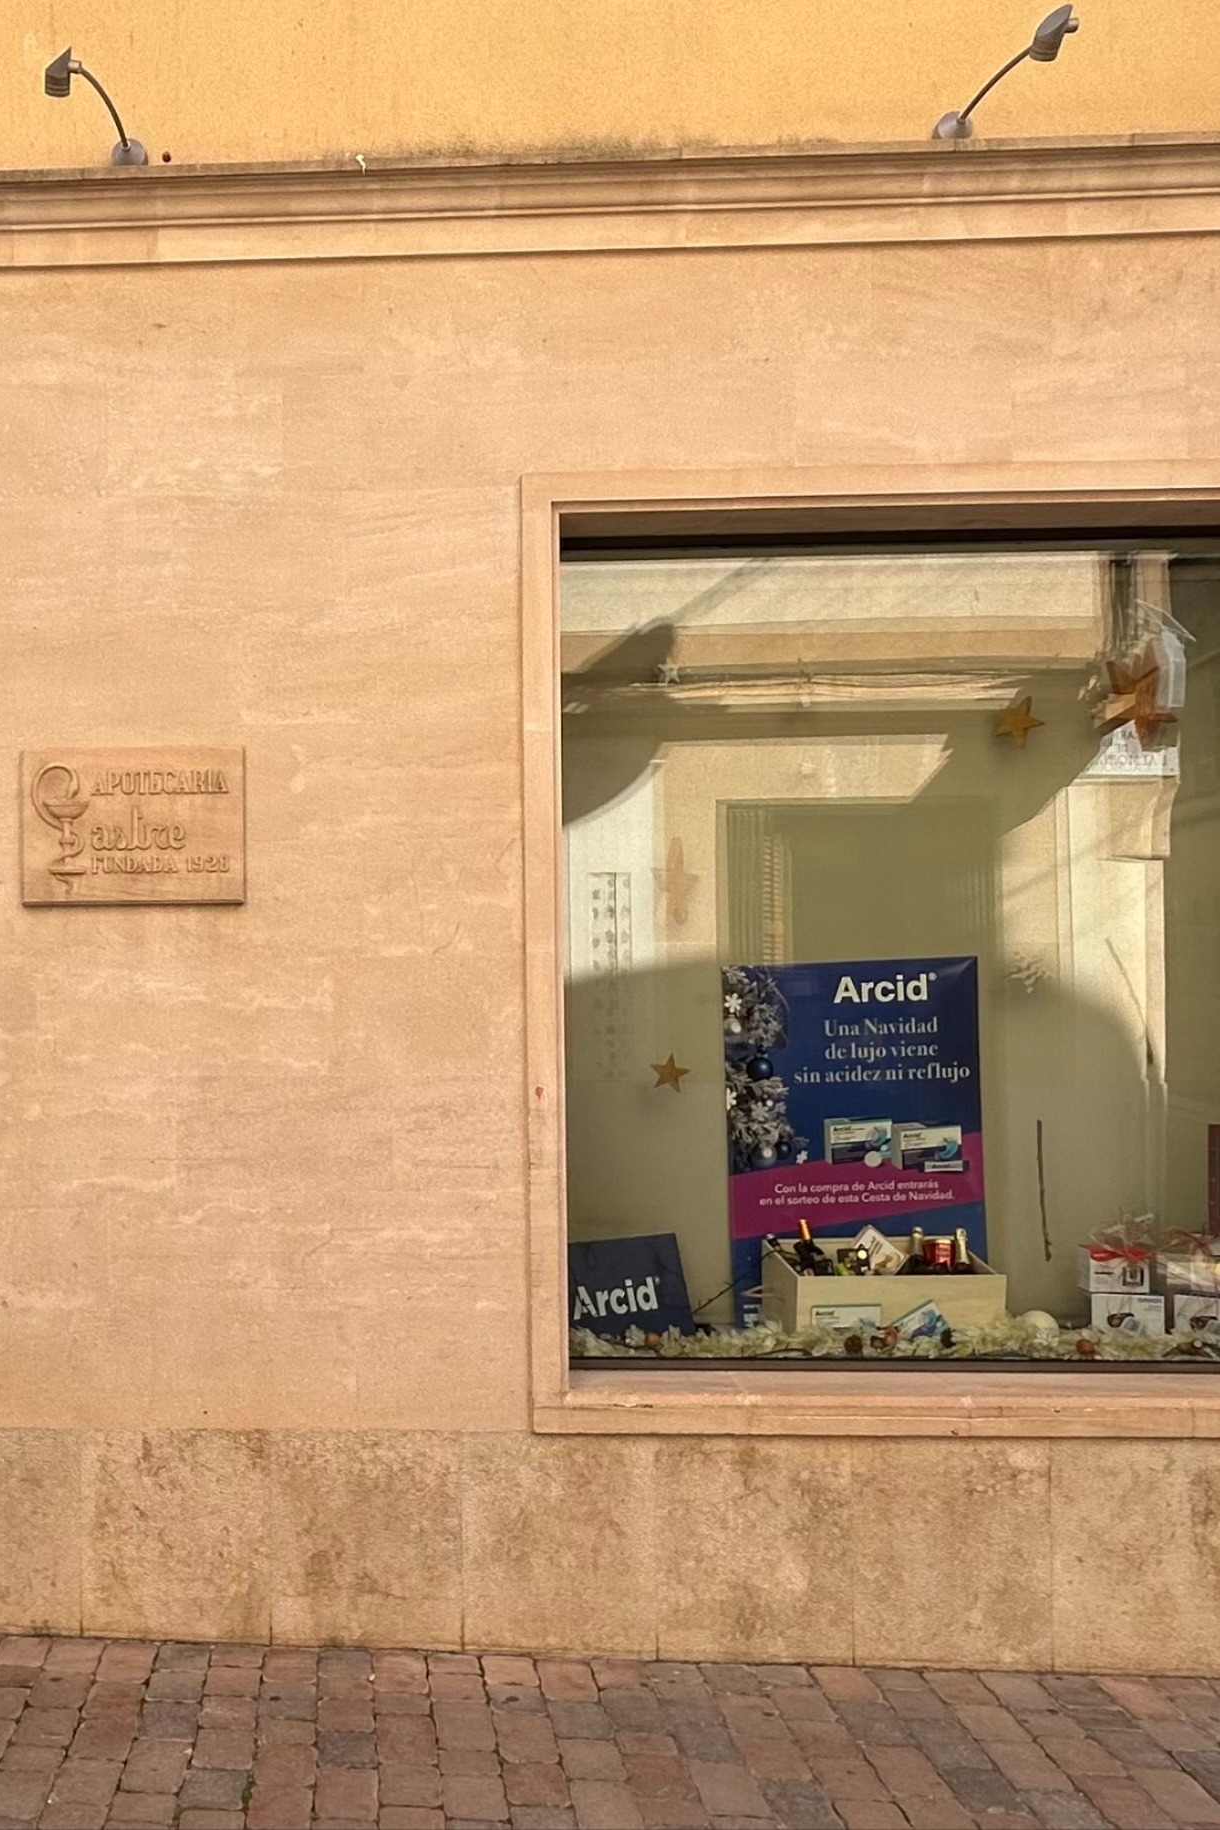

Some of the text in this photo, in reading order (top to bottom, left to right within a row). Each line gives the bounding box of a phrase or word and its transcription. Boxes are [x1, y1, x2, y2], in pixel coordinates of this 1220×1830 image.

[91, 769, 230, 796] APOTECARIA
[92, 856, 178, 876] FUNDADA
[833, 973, 929, 1004] Arcid
[824, 1016, 938, 1037] Una Navidad
[824, 1041, 939, 1063] de lujo viene
[793, 1061, 971, 1083] sin acidez ni reflujo
[759, 1197, 772, 1205] en
[774, 1195, 785, 1204] el
[787, 1195, 819, 1205] sorteo
[822, 1193, 836, 1204] de
[838, 1194, 859, 1203] esta
[861, 1192, 891, 1202] Cesta
[893, 1190, 906, 1201] de
[774, 1179, 939, 1194] Con la compra de Arcid entrarás
[573, 1276, 659, 1321] Arcid
